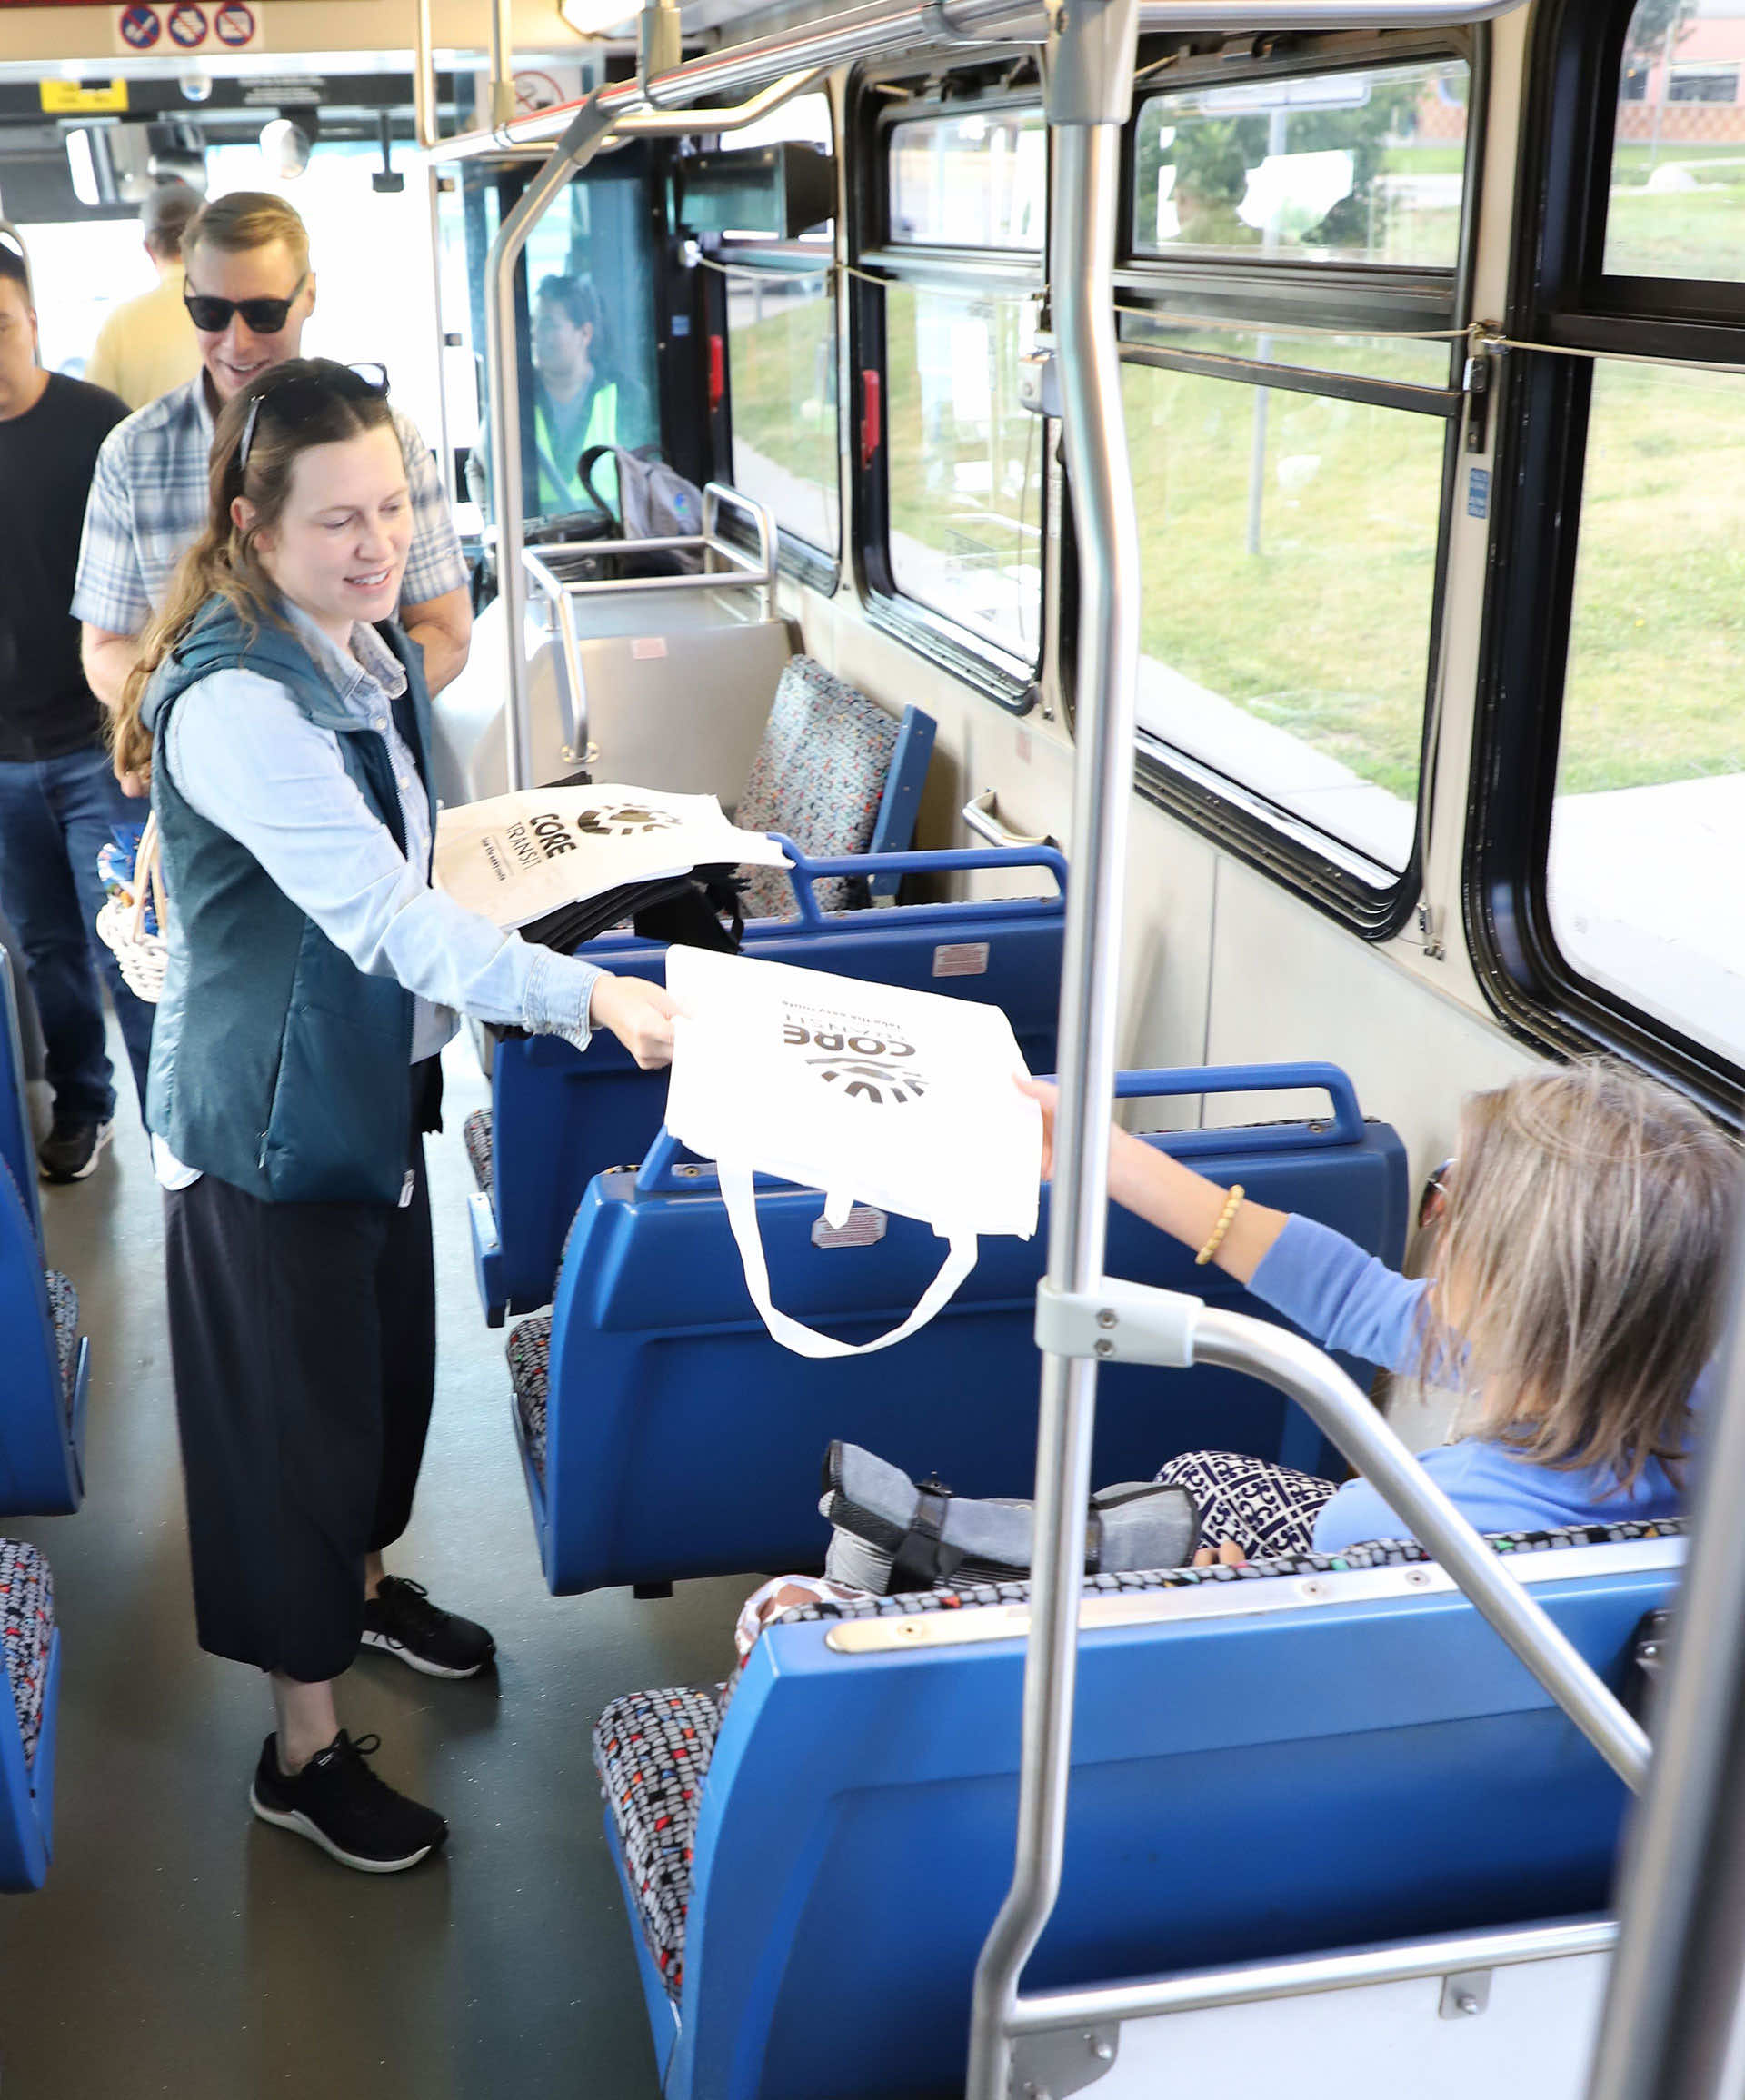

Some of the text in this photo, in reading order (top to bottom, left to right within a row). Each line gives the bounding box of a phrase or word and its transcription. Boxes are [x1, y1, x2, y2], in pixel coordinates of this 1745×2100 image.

[505, 821, 543, 871] TRANSIT
[529, 813, 577, 859] CORE
[783, 1024, 916, 1057] CORE
